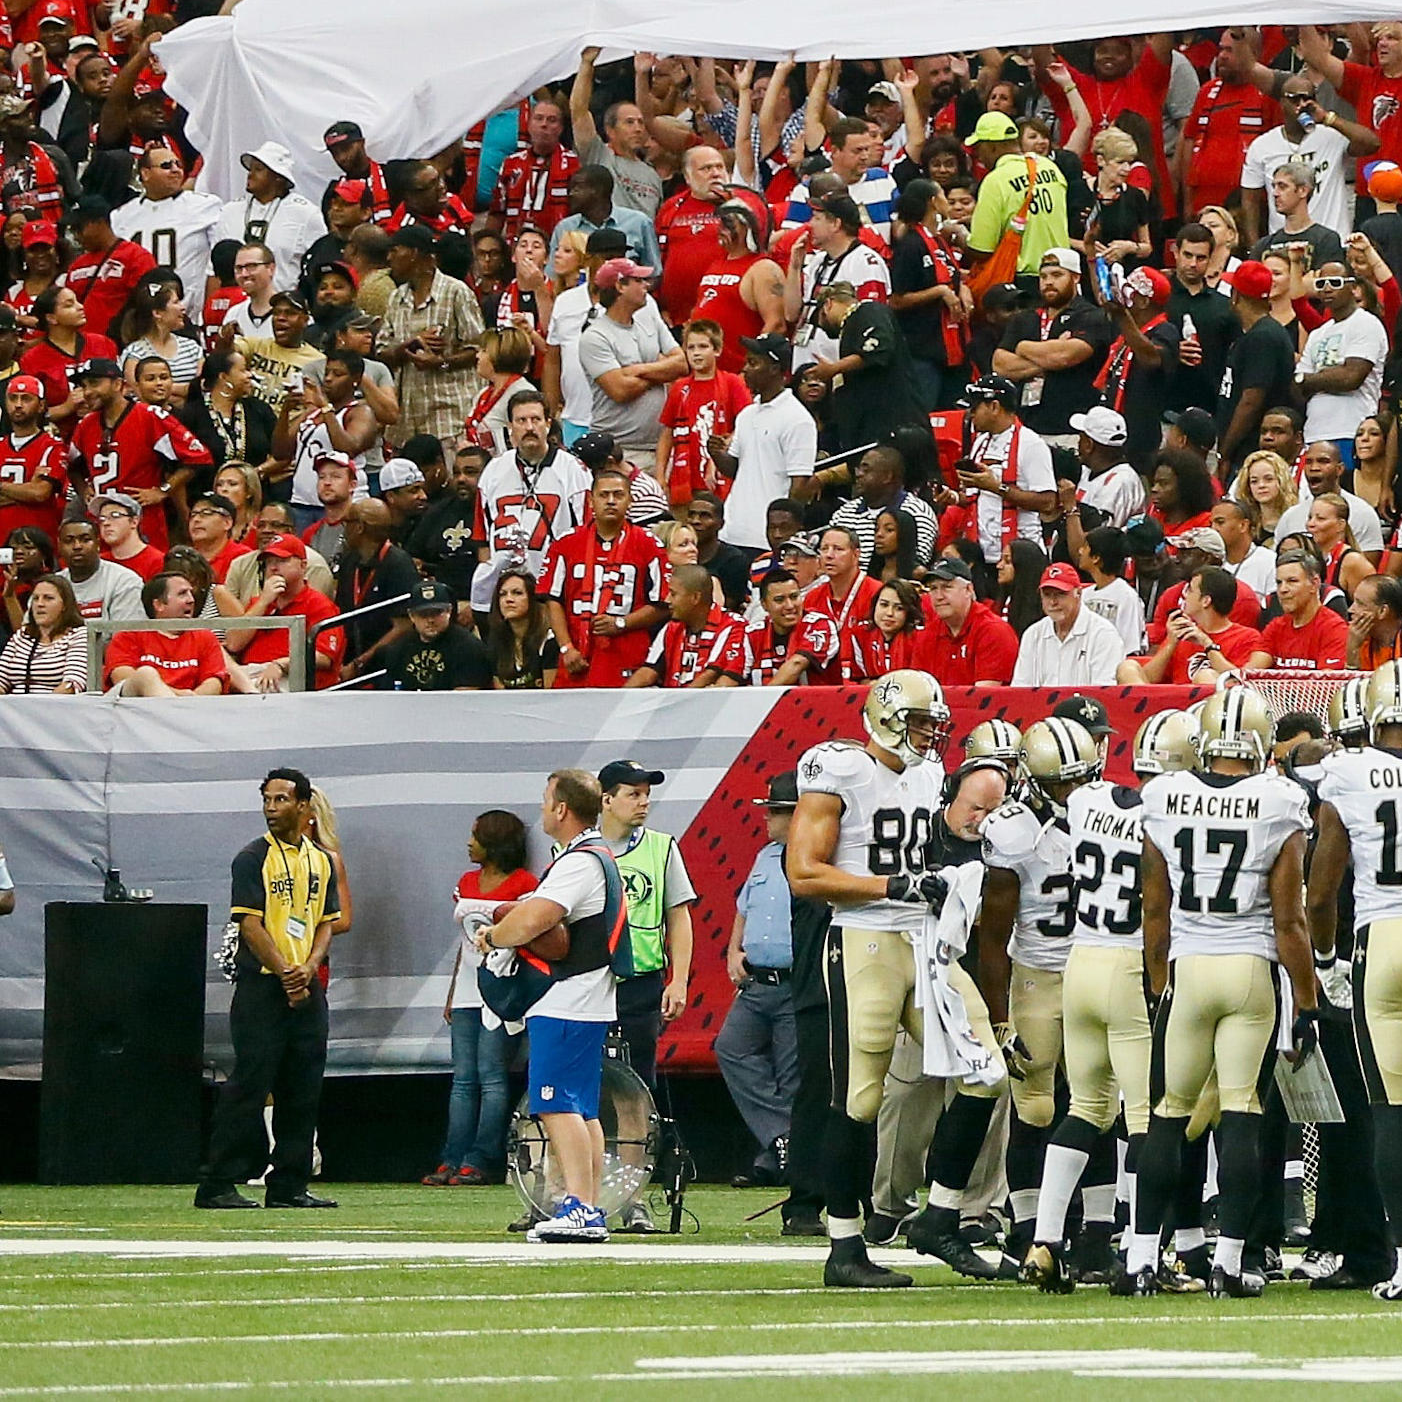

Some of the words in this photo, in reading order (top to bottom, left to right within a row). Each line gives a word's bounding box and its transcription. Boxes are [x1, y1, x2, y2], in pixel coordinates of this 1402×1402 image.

[93, 450, 120, 491] 2
[1166, 792, 1260, 821] MEACHEM
[888, 808, 931, 876] 80
[1173, 828, 1248, 914] 17
[1073, 840, 1144, 935] 23
